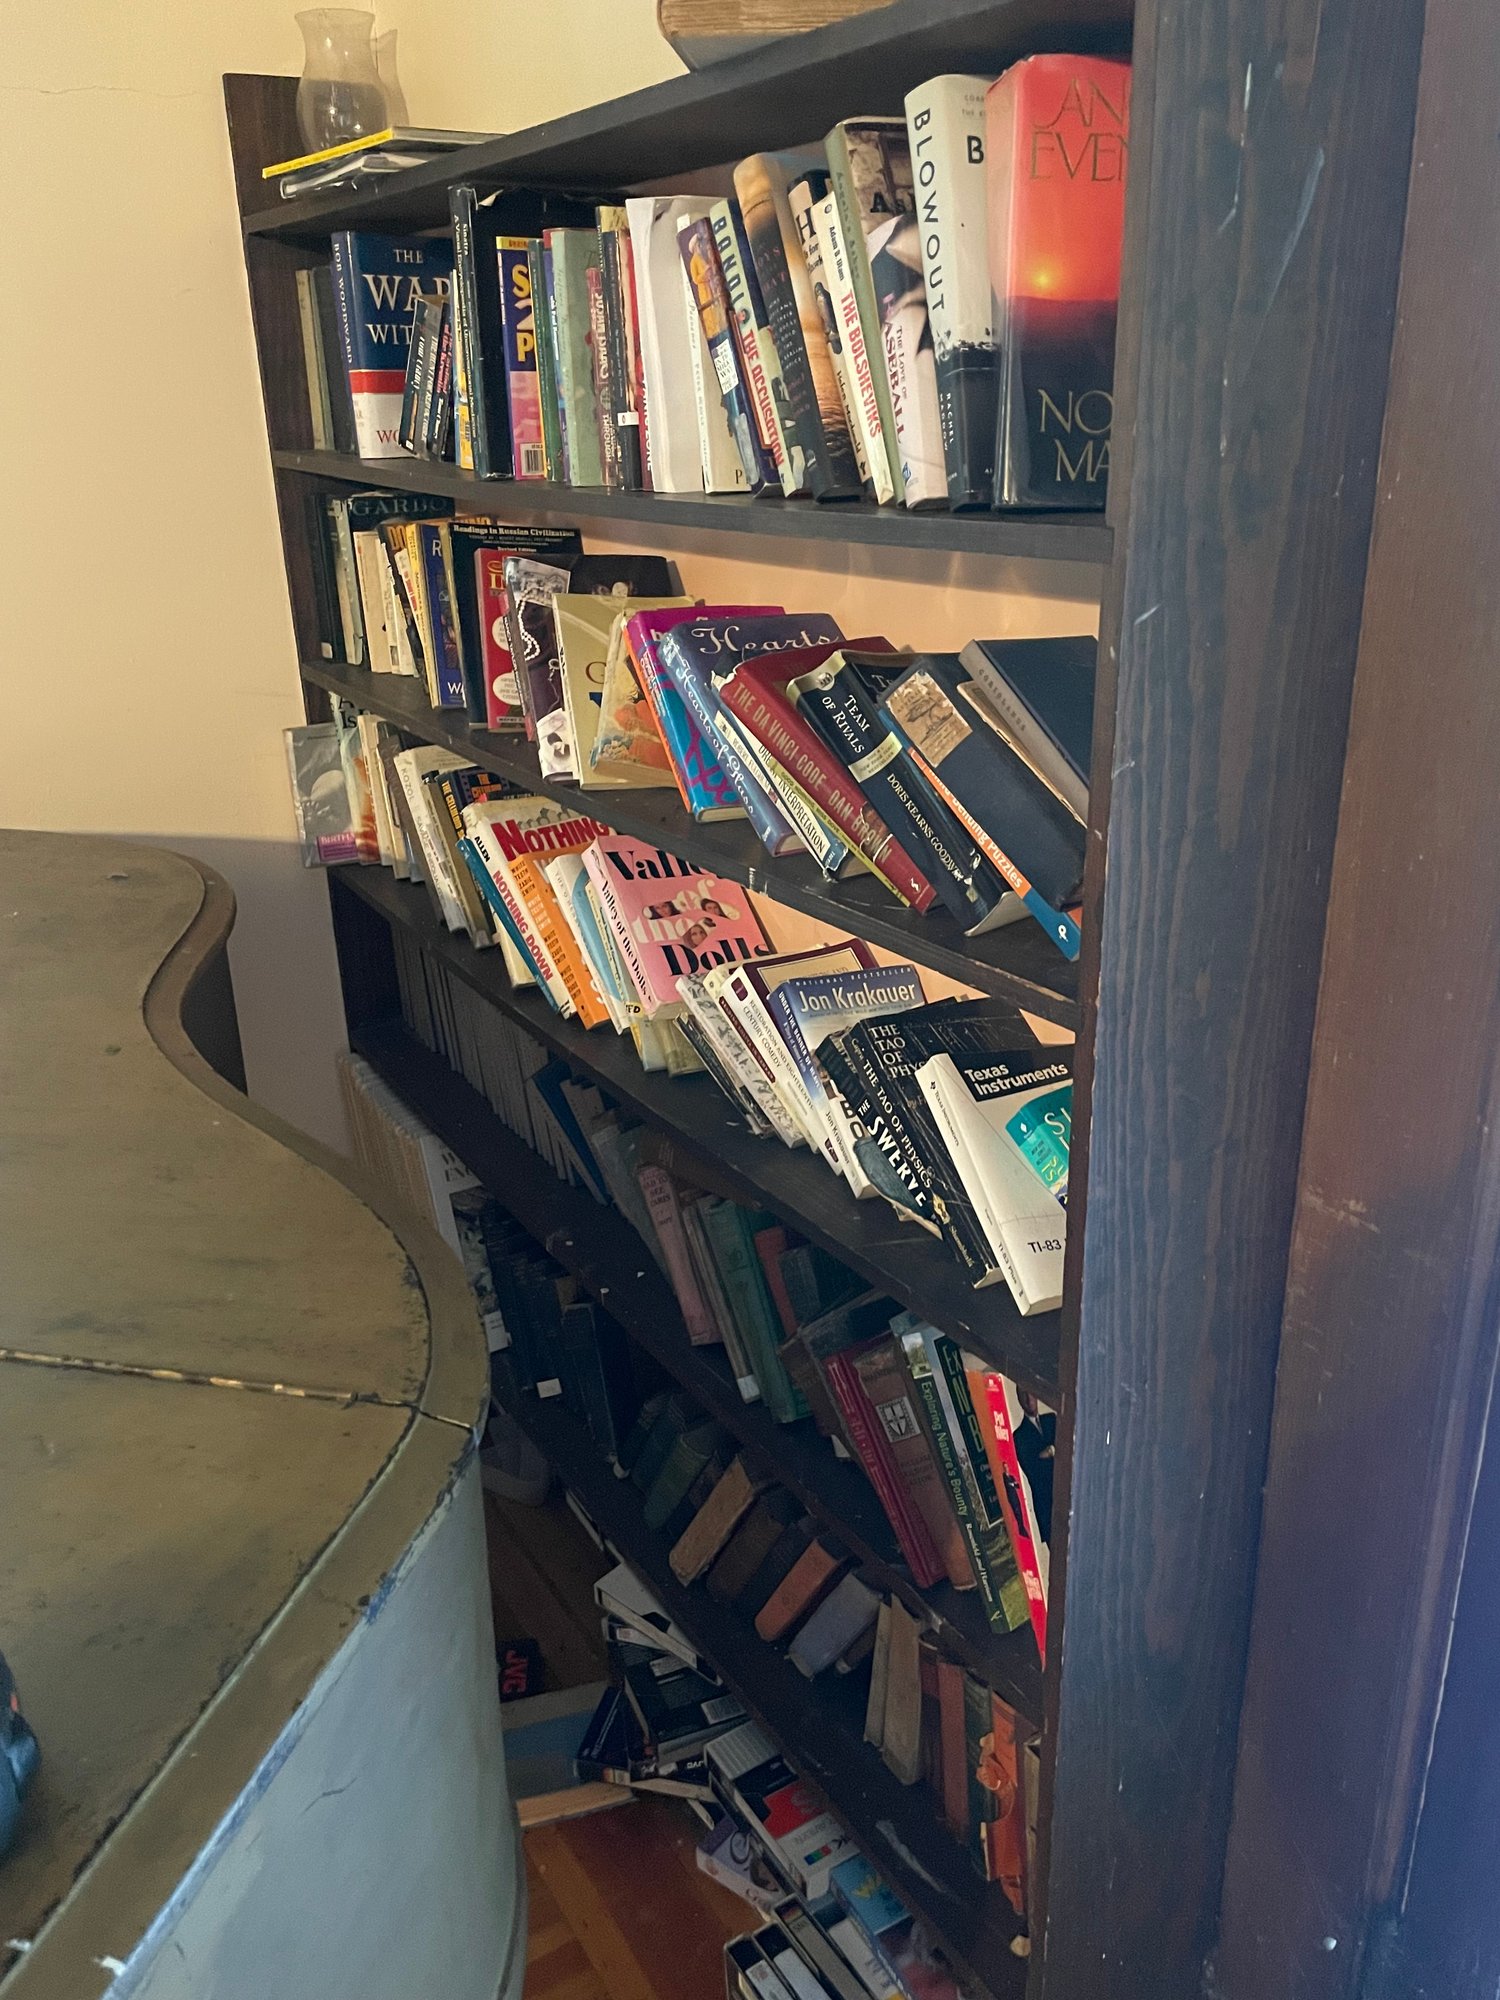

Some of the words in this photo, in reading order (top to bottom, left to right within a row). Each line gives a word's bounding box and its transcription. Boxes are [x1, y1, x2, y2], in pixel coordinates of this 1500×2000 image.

[796, 207, 816, 245] H
[913, 107, 945, 312] BLOWOUT
[333, 242, 343, 271] BOB
[393, 249, 424, 264] THE
[708, 215, 749, 304] BANDI
[828, 226, 839, 249] Adam
[834, 258, 846, 281] Ulam
[336, 277, 355, 363] WOODWARD
[839, 288, 859, 327] THE
[742, 328, 759, 361] THE
[751, 364, 785, 465] ACCUSATION
[847, 327, 883, 437] BOLSHEVIKS
[884, 322, 905, 444] ASEBALL
[601, 414, 612, 462] THROUGH
[946, 392, 954, 443] RACHEL
[454, 524, 488, 535] Readings
[498, 527, 529, 536] Russian
[530, 528, 575, 537] Civilization
[691, 626, 841, 654] Hearts
[821, 696, 836, 712] OF
[832, 710, 865, 754] RIVALS
[842, 694, 872, 732] TEAM
[673, 658, 720, 735] Hearts
[723, 753, 761, 815] Glass
[398, 767, 417, 800] KOZOL
[729, 681, 756, 709] THE
[749, 704, 773, 728] DA
[764, 720, 801, 760] VINCI
[793, 754, 827, 790] CODE
[824, 788, 855, 820] DAN
[847, 815, 893, 864] BROWN
[774, 777, 830, 851] INTERPRETATION
[885, 773, 910, 802] DORIS
[903, 799, 934, 837] KEARNS
[471, 835, 492, 861] ALLEN
[490, 817, 610, 862] NOTHING
[985, 839, 1025, 887] Puzzles
[490, 869, 531, 933] NOTHING
[523, 933, 555, 981] DOWN
[597, 880, 621, 920] Valley
[615, 920, 626, 934] of
[621, 936, 636, 957] the
[629, 957, 652, 994] Dolls
[659, 937, 771, 977] Dolls
[796, 978, 843, 986] NATIONAL
[851, 967, 911, 980] BESTSELLER
[777, 991, 792, 1014] UNDER
[799, 990, 832, 1013] Jon
[832, 982, 916, 1009] Krakauer
[742, 1006, 764, 1037] CENTURY
[760, 1037, 781, 1067] COMEDY
[747, 1000, 779, 1046] RESTORATION
[775, 1047, 787, 1063] AND
[786, 1014, 797, 1029] THE
[791, 1028, 808, 1056] BANNER
[868, 1024, 900, 1039] THE
[874, 1036, 906, 1051] TAO
[804, 1056, 812, 1065] OF
[883, 1051, 903, 1066] OF
[964, 1063, 1009, 1083] Texas
[974, 1062, 1069, 1096] Instruments
[858, 1099, 871, 1117] THE
[860, 1059, 880, 1087] THE
[874, 1086, 895, 1114] TAO
[889, 1114, 905, 1133] OF
[900, 1135, 934, 1188] PHYSICS
[824, 1111, 835, 1125] Jon
[830, 1125, 852, 1163] Krakauer
[865, 1116, 933, 1207] SWERVE
[1027, 1239, 1062, 1254] TI-83
[916, 1381, 945, 1431] Exploring
[933, 1429, 961, 1475] Nature's
[947, 1476, 973, 1517] Bounty
